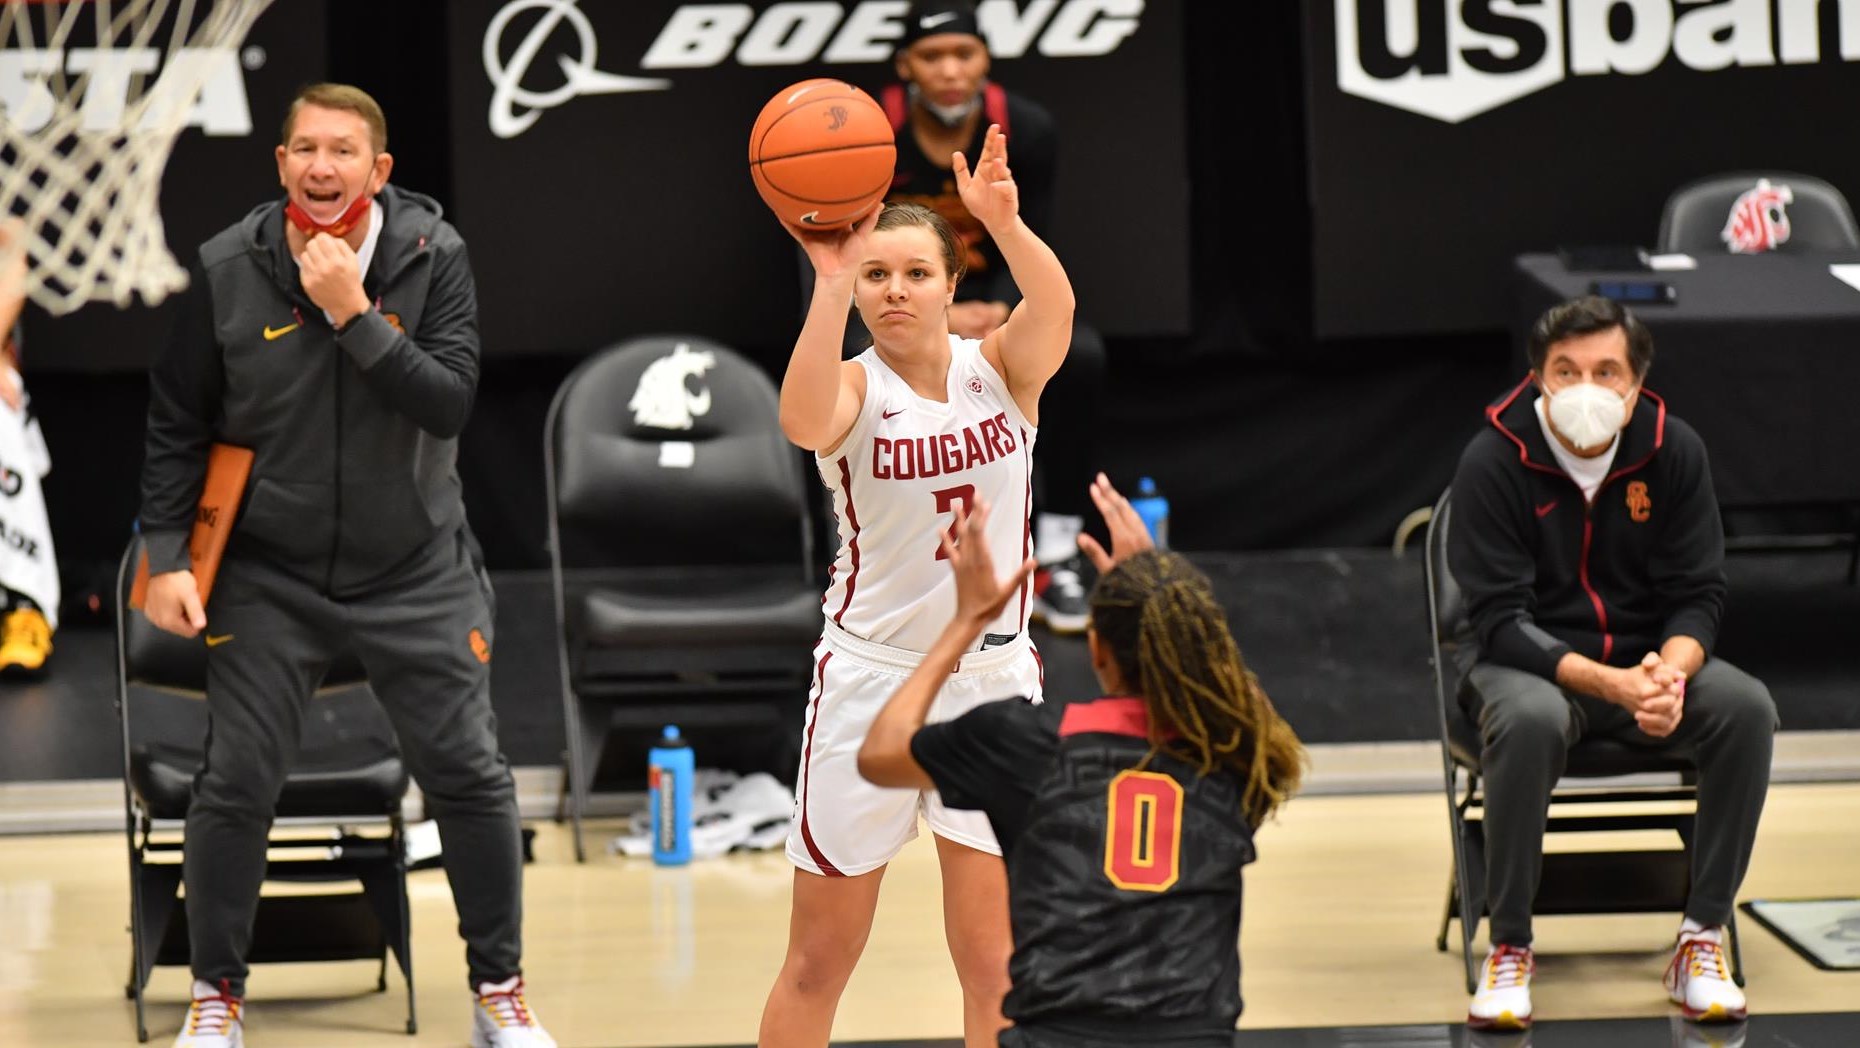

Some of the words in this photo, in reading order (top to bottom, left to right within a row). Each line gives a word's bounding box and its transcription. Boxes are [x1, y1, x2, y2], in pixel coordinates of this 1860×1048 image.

[640, 0, 1145, 68] BOENG
[872, 411, 1017, 480] COUGARS
[1104, 769, 1184, 893] 0
